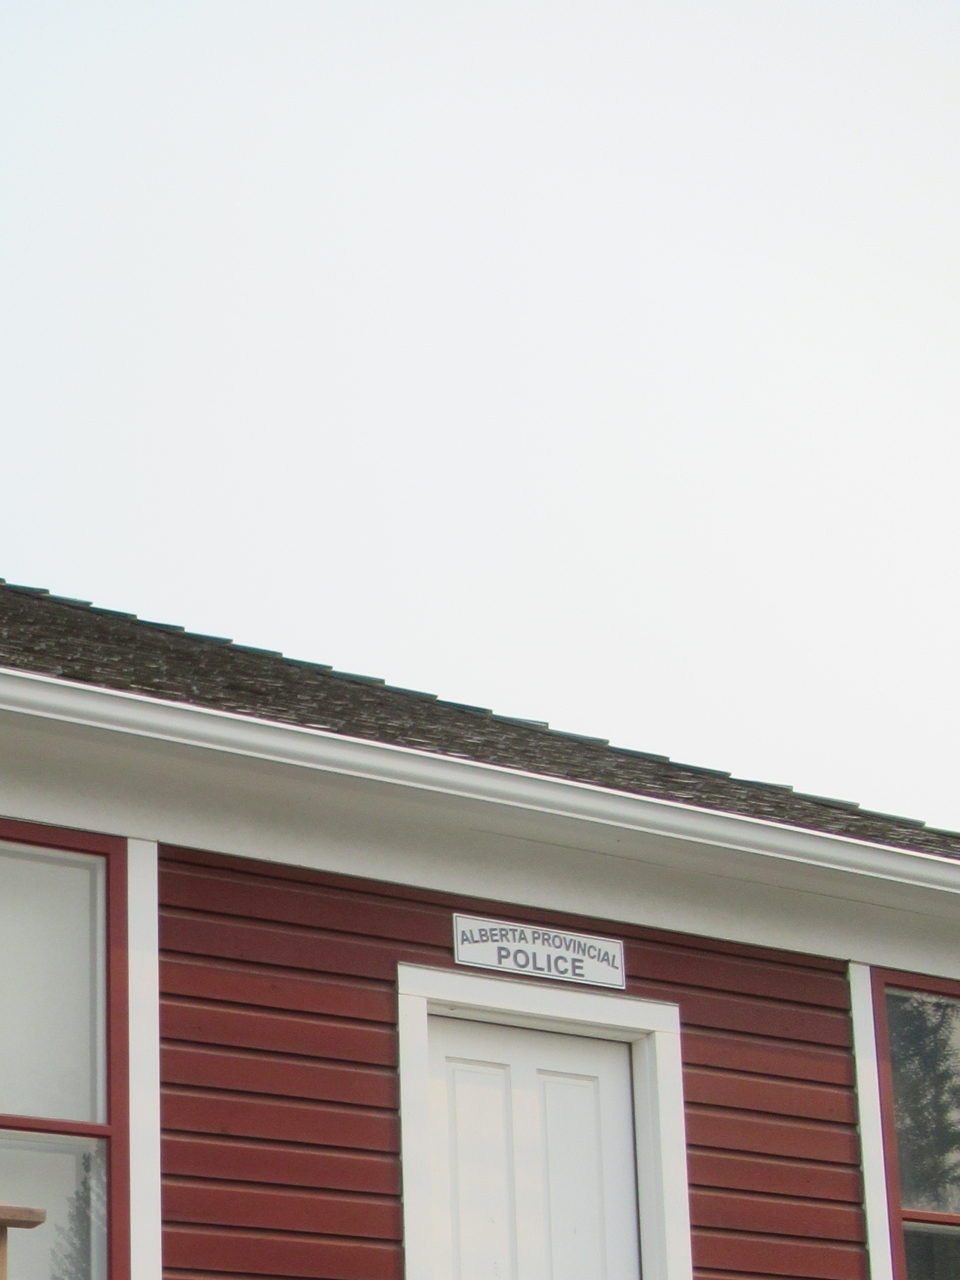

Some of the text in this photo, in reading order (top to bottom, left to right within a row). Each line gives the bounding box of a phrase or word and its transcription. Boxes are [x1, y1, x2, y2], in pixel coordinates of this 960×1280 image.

[461, 928, 619, 970] ALBERTA PROVINCIAL
[496, 946, 585, 978] POLICE
